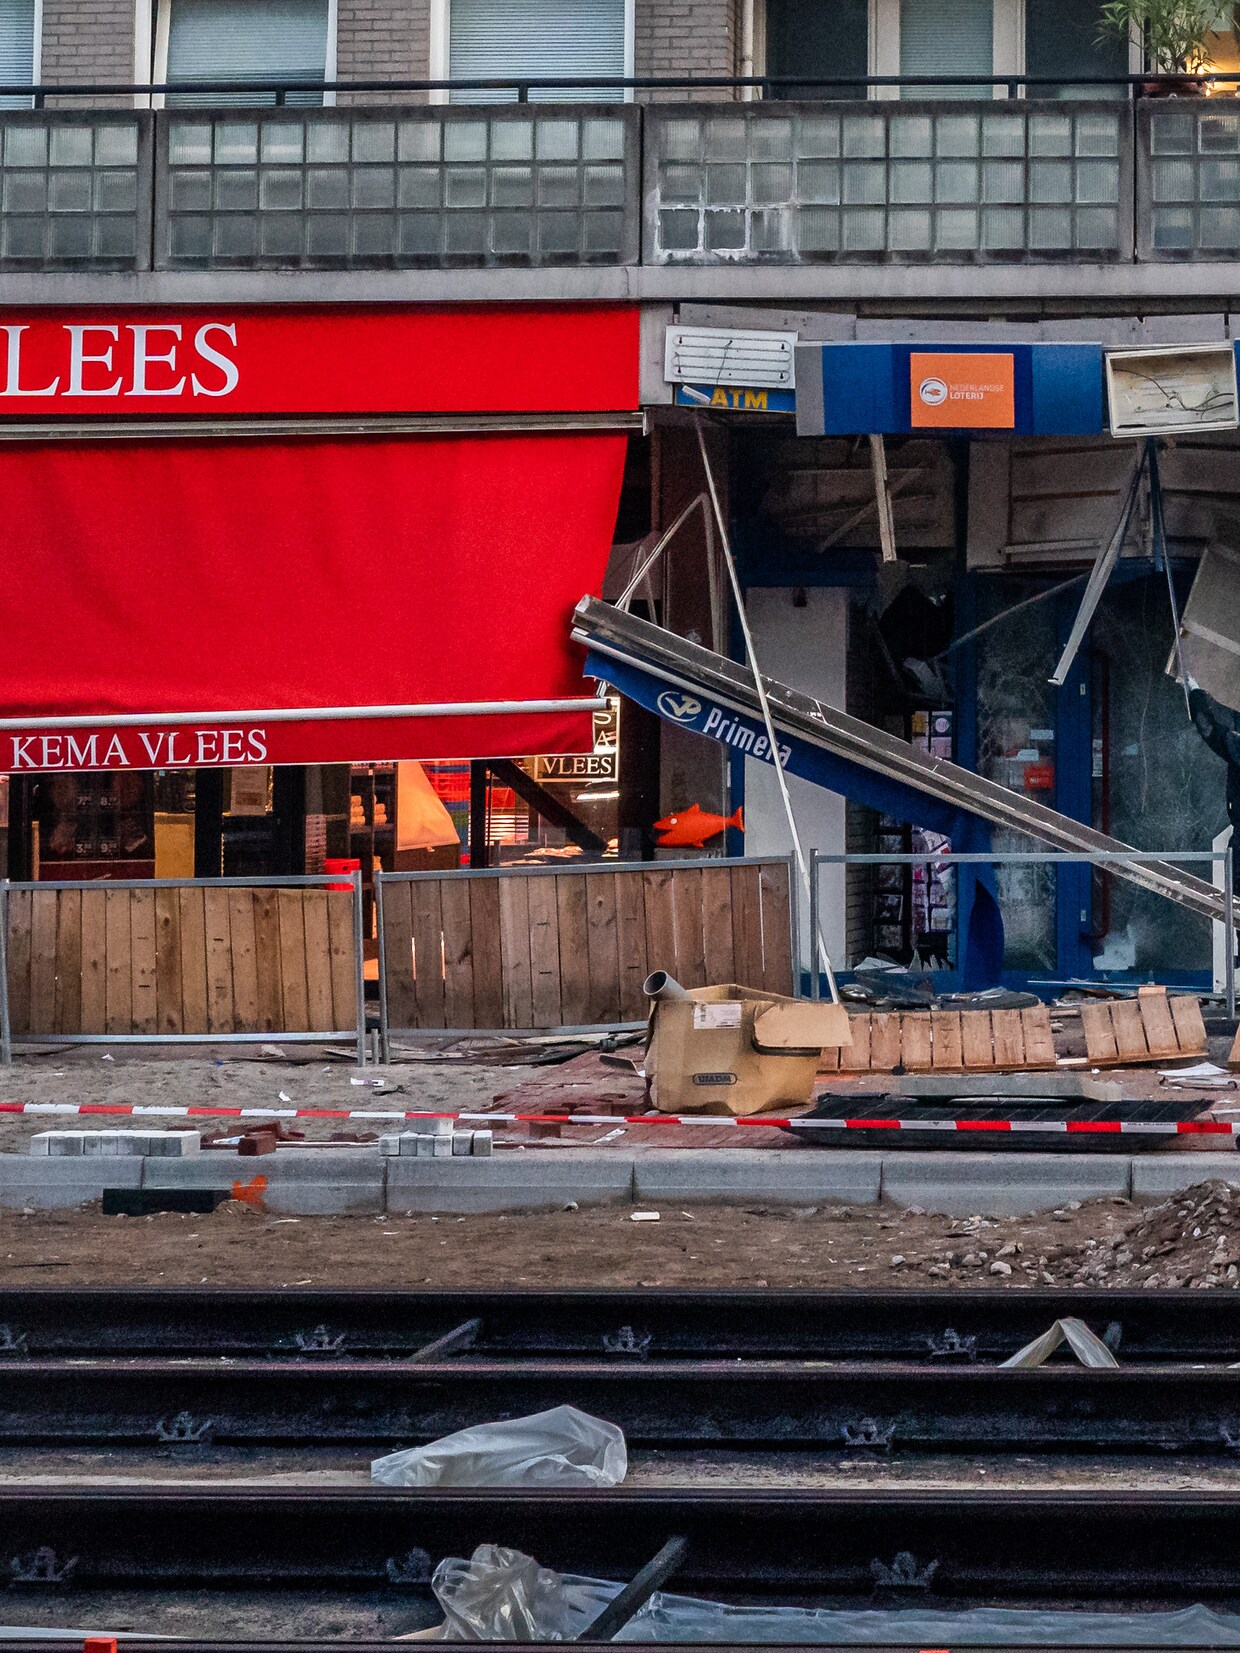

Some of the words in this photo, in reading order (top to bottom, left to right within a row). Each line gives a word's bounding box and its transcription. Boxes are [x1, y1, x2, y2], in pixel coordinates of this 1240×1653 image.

[0, 323, 239, 397] LEES
[949, 384, 1005, 392] NEDERLANDSE
[949, 392, 984, 400] LOTERIJ
[711, 388, 768, 409] ATM
[10, 733, 131, 768] KEMA
[138, 729, 268, 765] VLEES
[543, 757, 612, 774] VLEES
